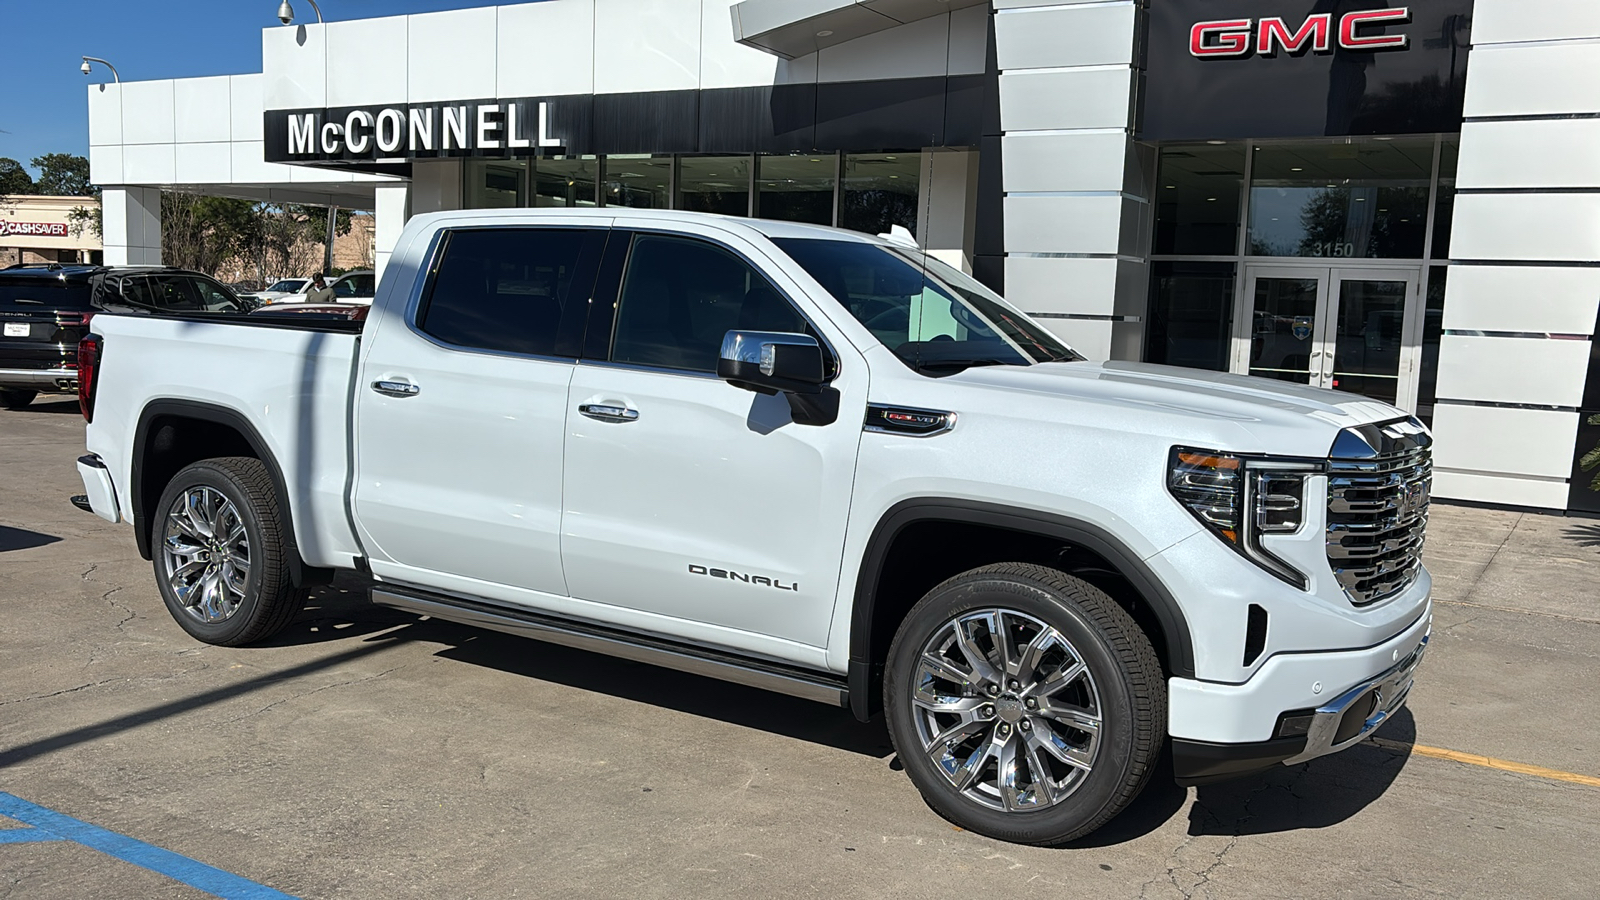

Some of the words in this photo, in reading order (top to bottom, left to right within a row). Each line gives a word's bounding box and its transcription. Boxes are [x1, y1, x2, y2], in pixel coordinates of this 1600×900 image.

[1189, 7, 1409, 57] GMC
[287, 101, 562, 155] McCONNELL
[8, 223, 64, 234] CASHSAVER
[1313, 242, 1354, 257] 3150
[688, 564, 798, 591] DENALI
